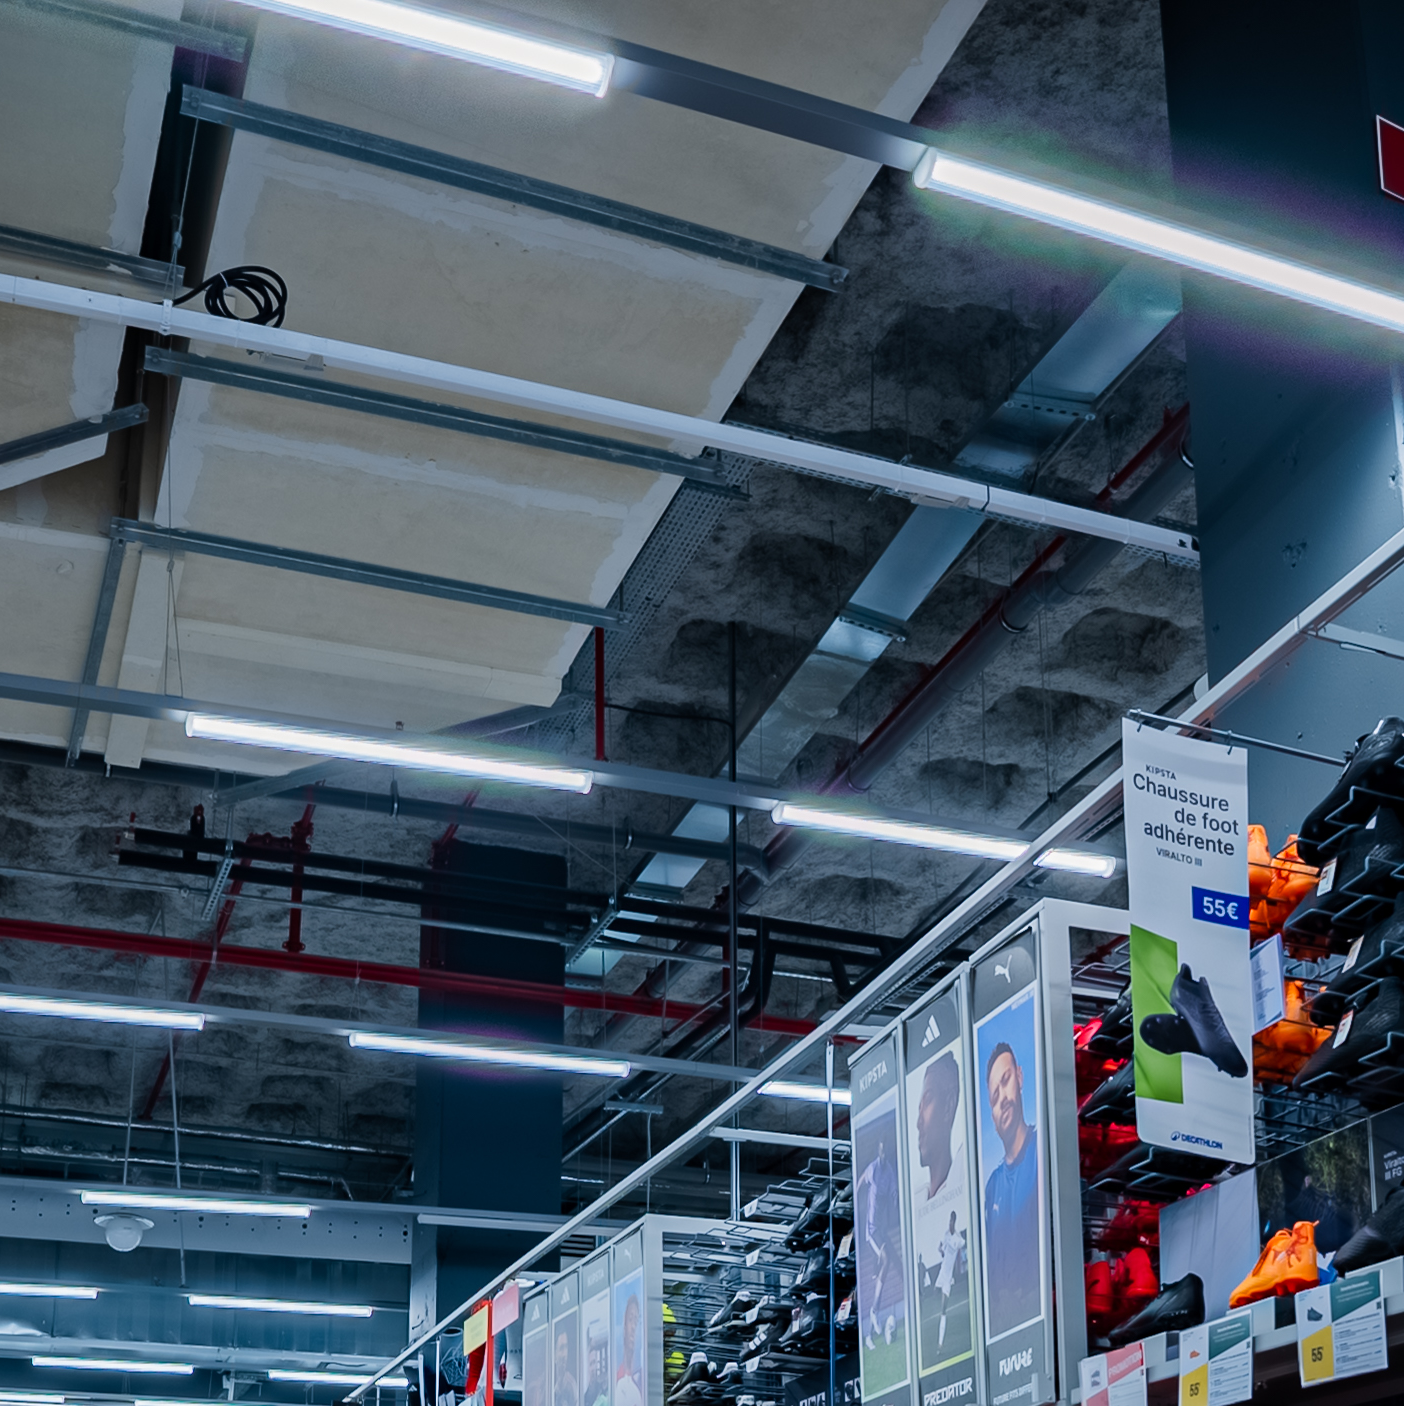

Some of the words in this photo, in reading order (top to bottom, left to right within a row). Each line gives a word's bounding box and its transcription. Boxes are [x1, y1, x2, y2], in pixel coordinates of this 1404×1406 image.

[1146, 764, 1177, 780] KIPSTA
[1133, 773, 1229, 812] Chaussure
[1174, 808, 1196, 826] de
[1202, 813, 1239, 835] foot
[1144, 822, 1235, 856] adhérente
[1156, 847, 1193, 865] VIRALTO
[1203, 897, 1239, 921] 55€
[859, 1060, 888, 1094] KIPSTA
[1311, 1346, 1324, 1363] 55
